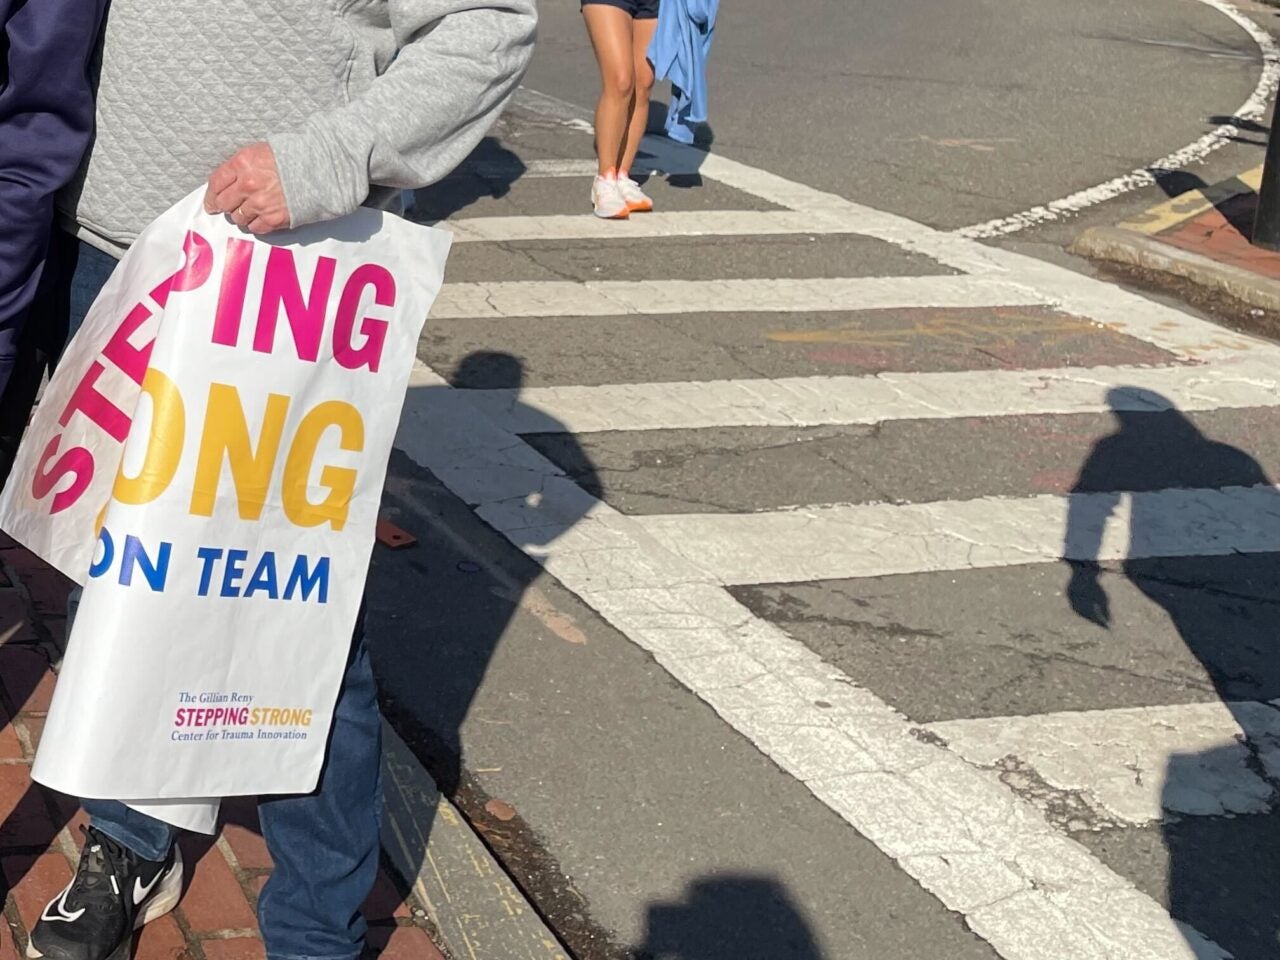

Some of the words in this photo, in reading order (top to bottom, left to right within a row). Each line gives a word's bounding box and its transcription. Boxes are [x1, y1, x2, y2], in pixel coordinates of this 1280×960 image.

[197, 547, 331, 604] TEAM
[179, 692, 196, 703] The
[199, 692, 228, 703] Gillian
[230, 692, 254, 705] Reny
[174, 707, 249, 727] STEPPING
[250, 707, 313, 727] STRONG
[171, 730, 203, 741] Center
[205, 729, 219, 741] for
[221, 729, 254, 740] Trauma
[257, 729, 308, 740] Innovation
